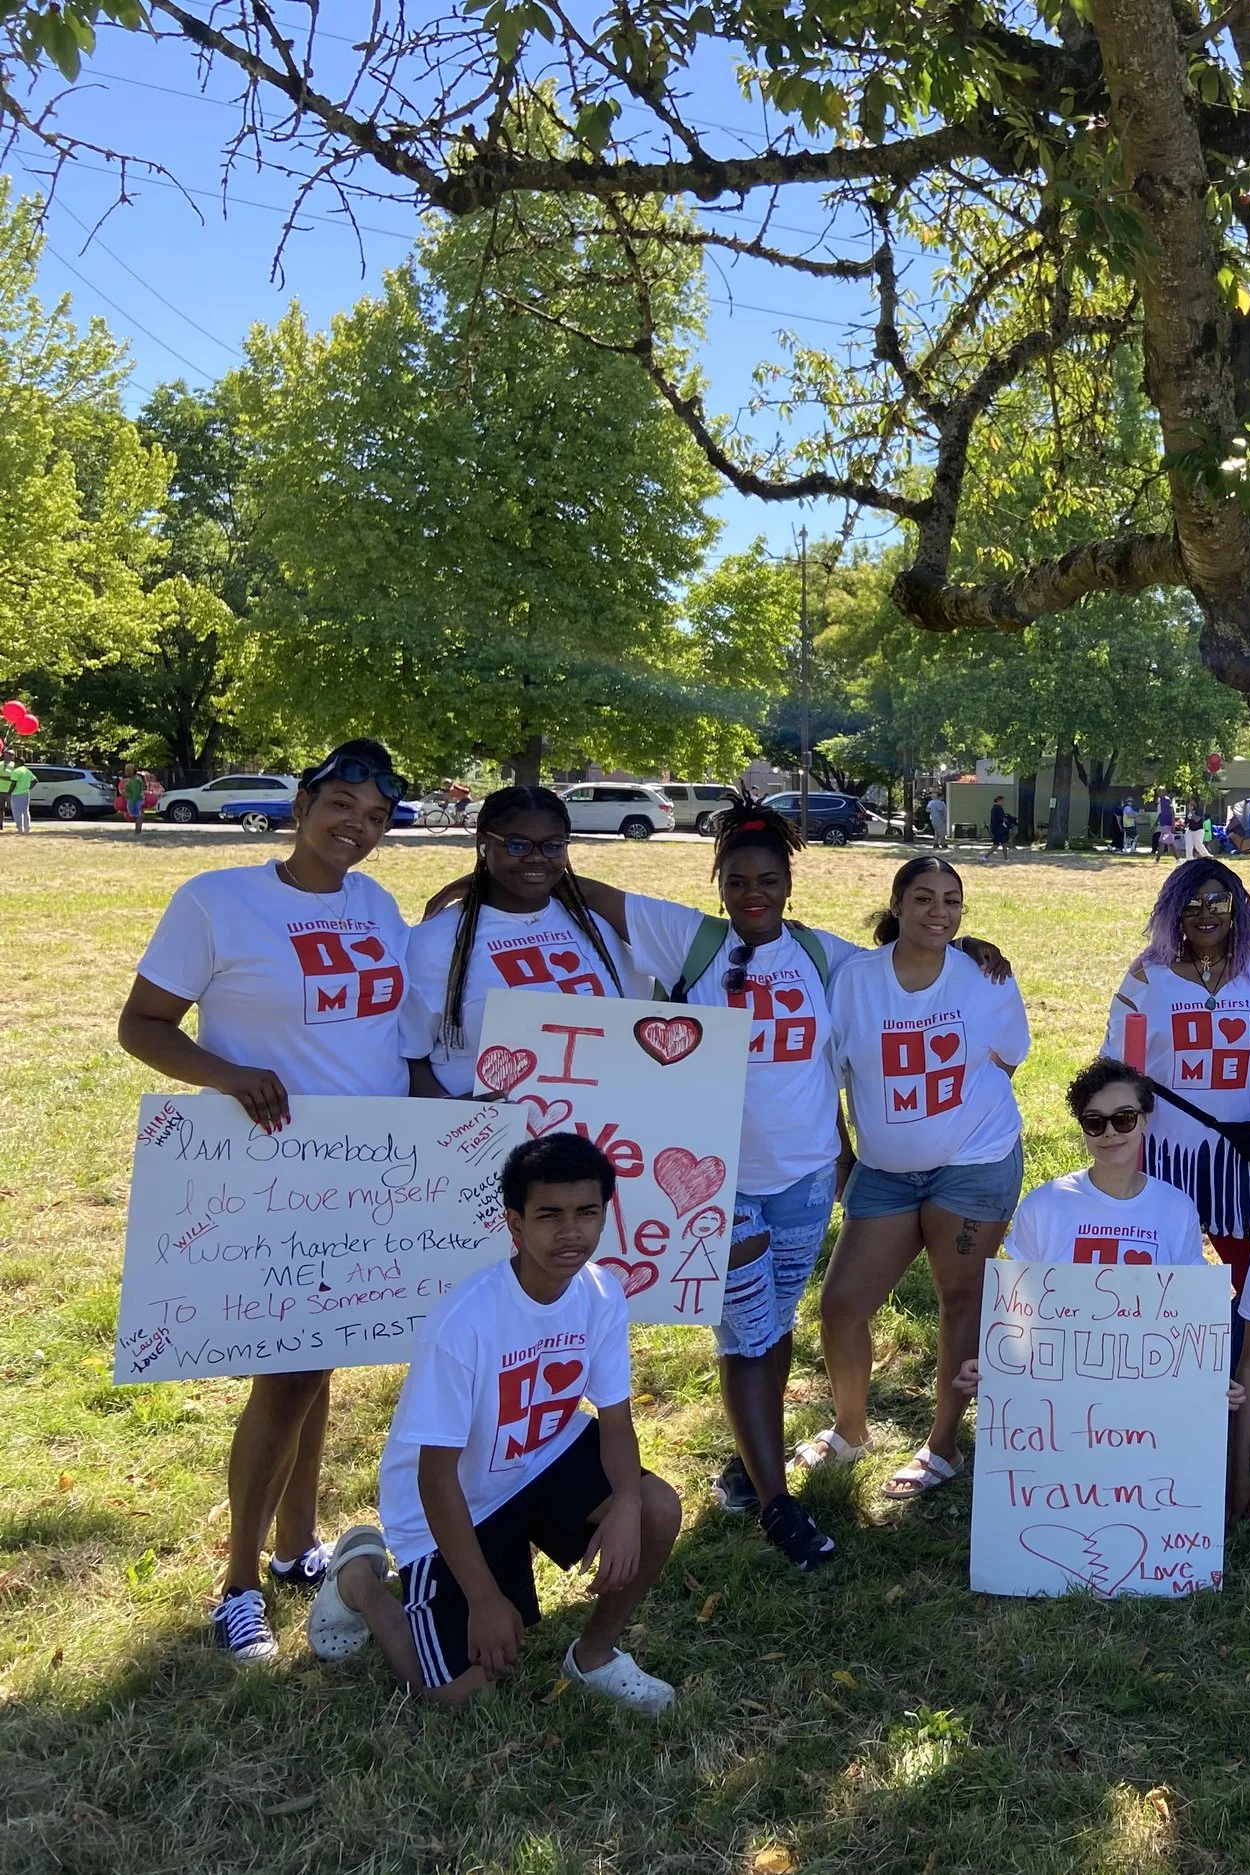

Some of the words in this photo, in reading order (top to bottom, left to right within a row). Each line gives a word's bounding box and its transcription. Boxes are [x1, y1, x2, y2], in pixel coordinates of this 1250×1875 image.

[487, 929, 574, 952] WomenFirst
[746, 968, 802, 984] menFirst
[883, 1008, 962, 1030] WomenFirst
[1171, 998, 1250, 1012] WomnFirst
[536, 1023, 605, 1087] I
[137, 1099, 176, 1147] SHINE
[246, 1121, 418, 1187] Somebody
[206, 1183, 246, 1214] do
[253, 1177, 340, 1213] Love
[347, 1175, 450, 1227] myself
[280, 1230, 377, 1259] harder
[384, 1233, 414, 1252] to
[1077, 1223, 1159, 1241] WomenFirst
[346, 1258, 403, 1284] And
[306, 1286, 407, 1315] Someone
[993, 1267, 1034, 1314] Who
[1037, 1267, 1081, 1321] Ever
[1091, 1268, 1141, 1321] Said
[1154, 1272, 1180, 1321] You
[979, 1395, 1065, 1452] Heal
[1071, 1403, 1158, 1450] from
[985, 1468, 1203, 1512] Trauma
